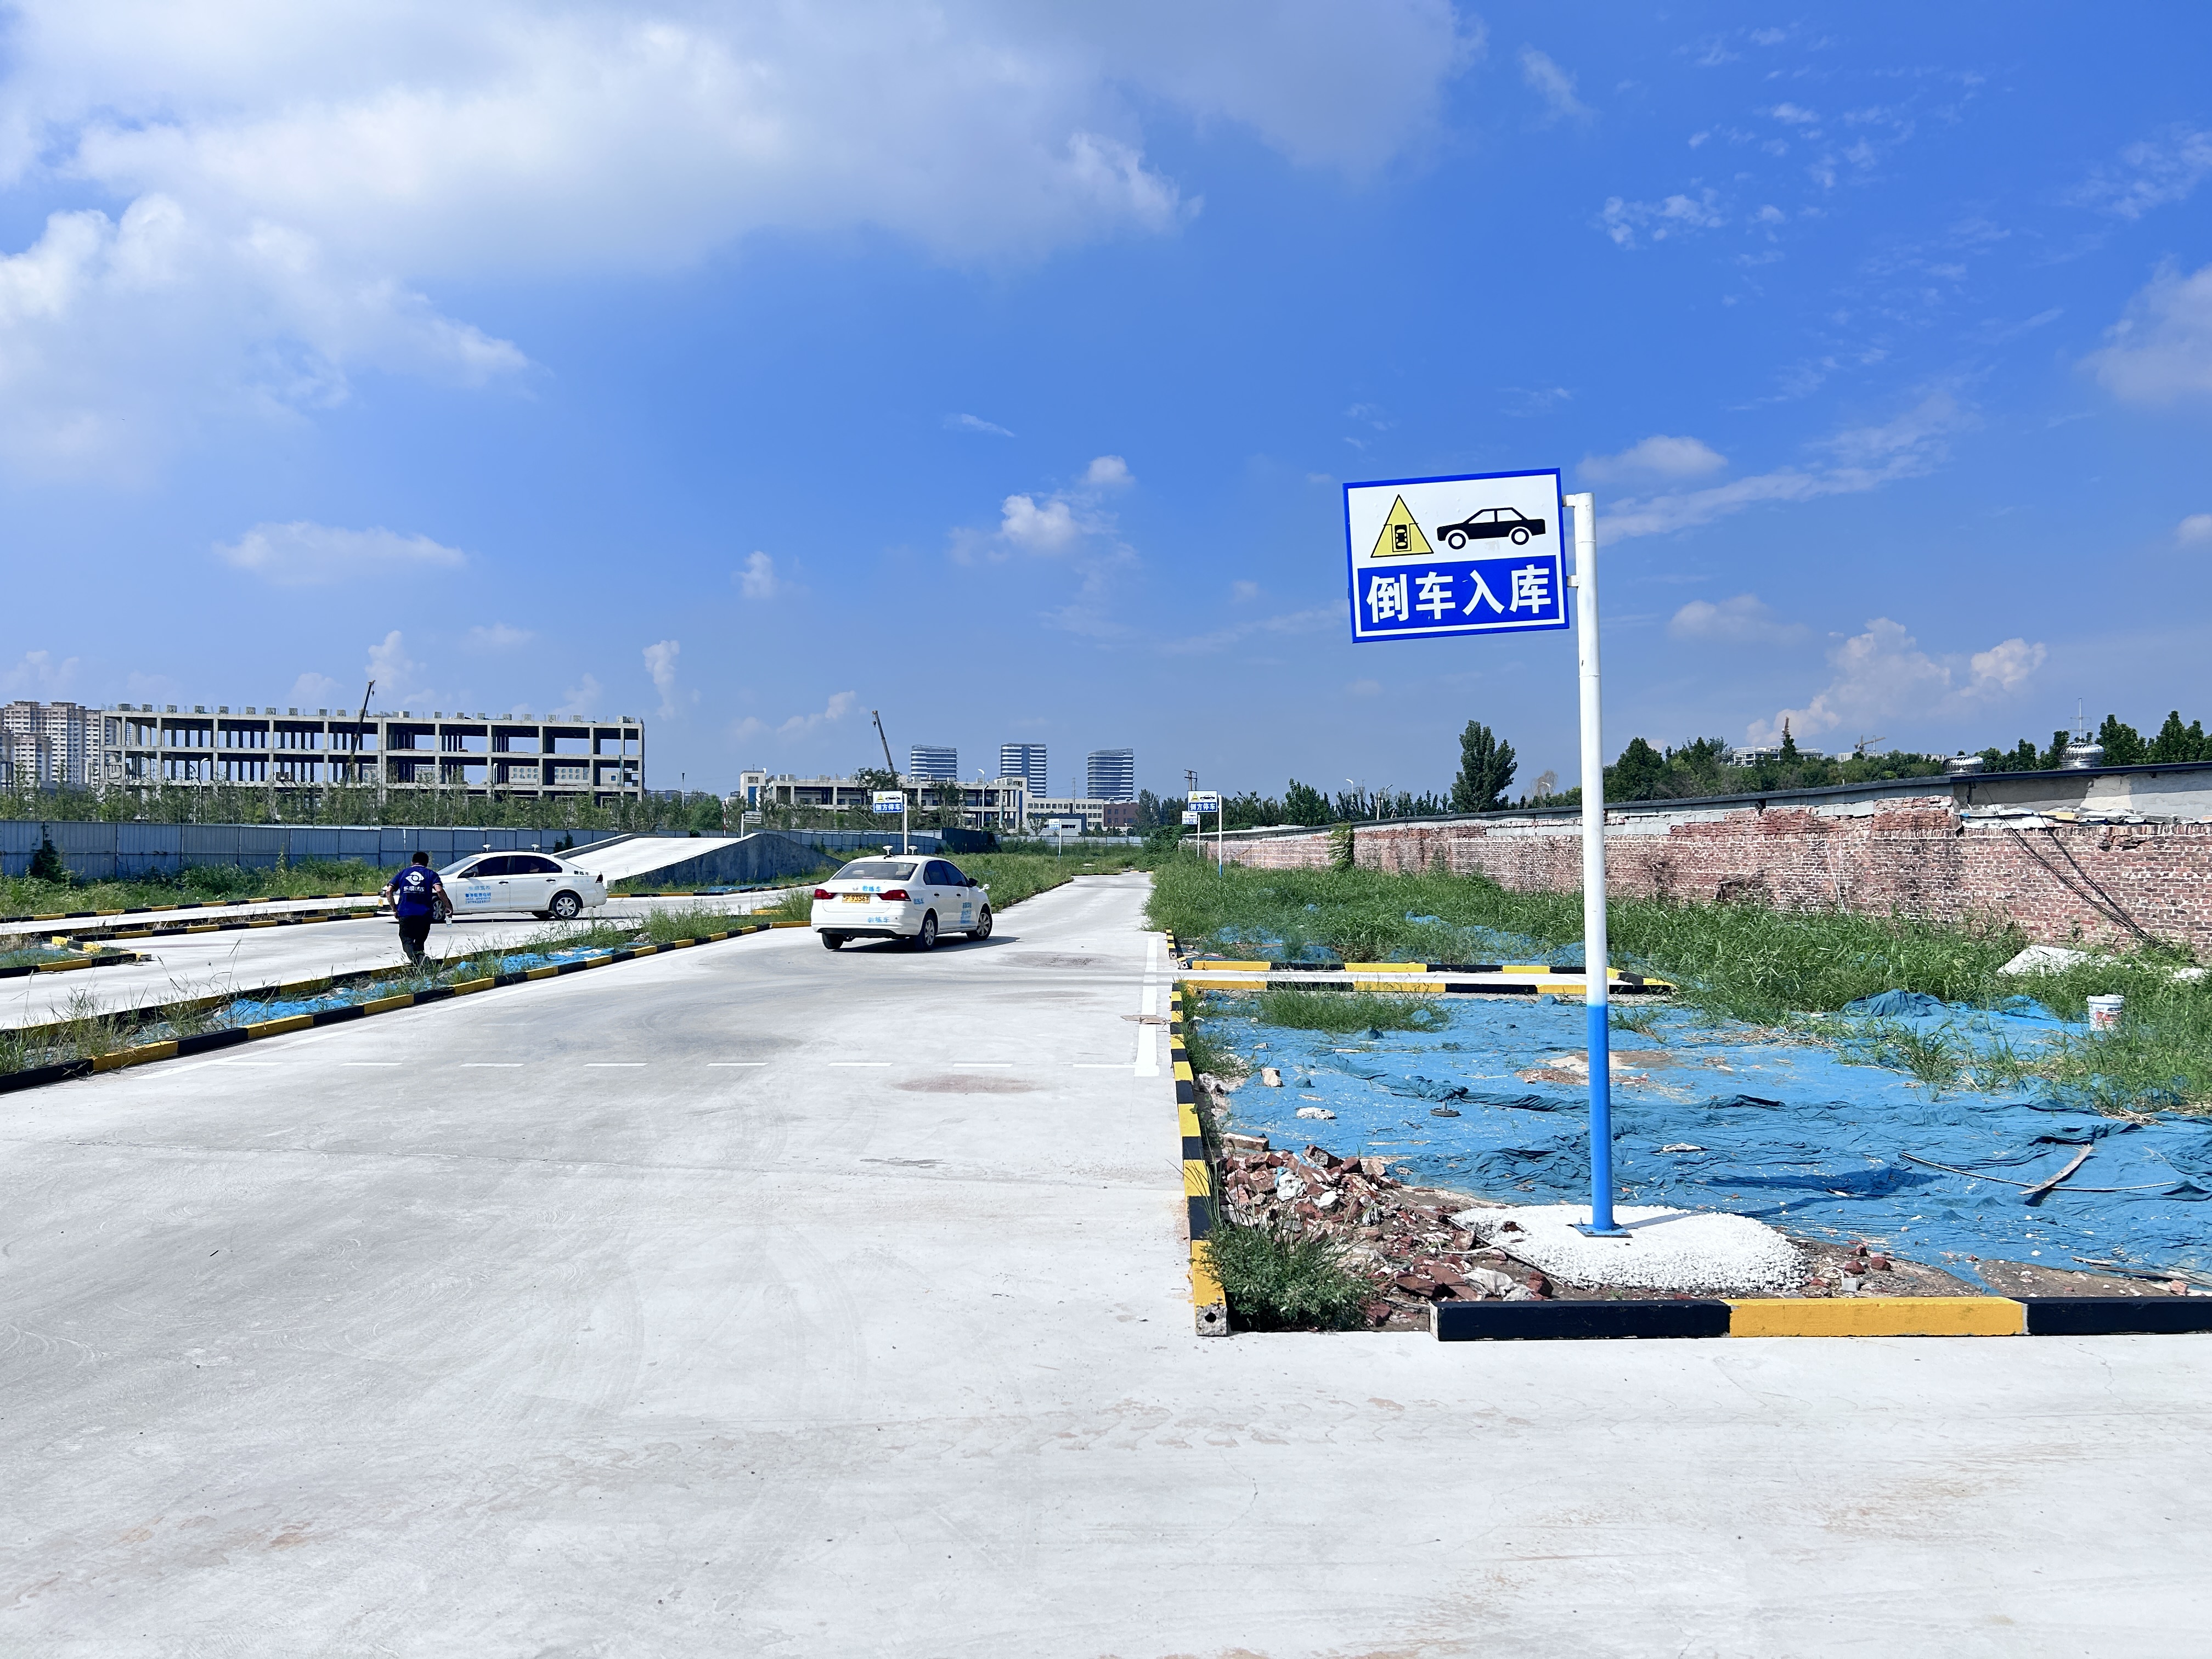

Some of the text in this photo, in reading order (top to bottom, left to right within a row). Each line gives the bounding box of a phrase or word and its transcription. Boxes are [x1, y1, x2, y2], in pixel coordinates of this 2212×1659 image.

[1367, 564, 1551, 623] 倒车入库
[875, 803, 901, 811] 侧方停车
[1190, 803, 1216, 811] 侧方停车
